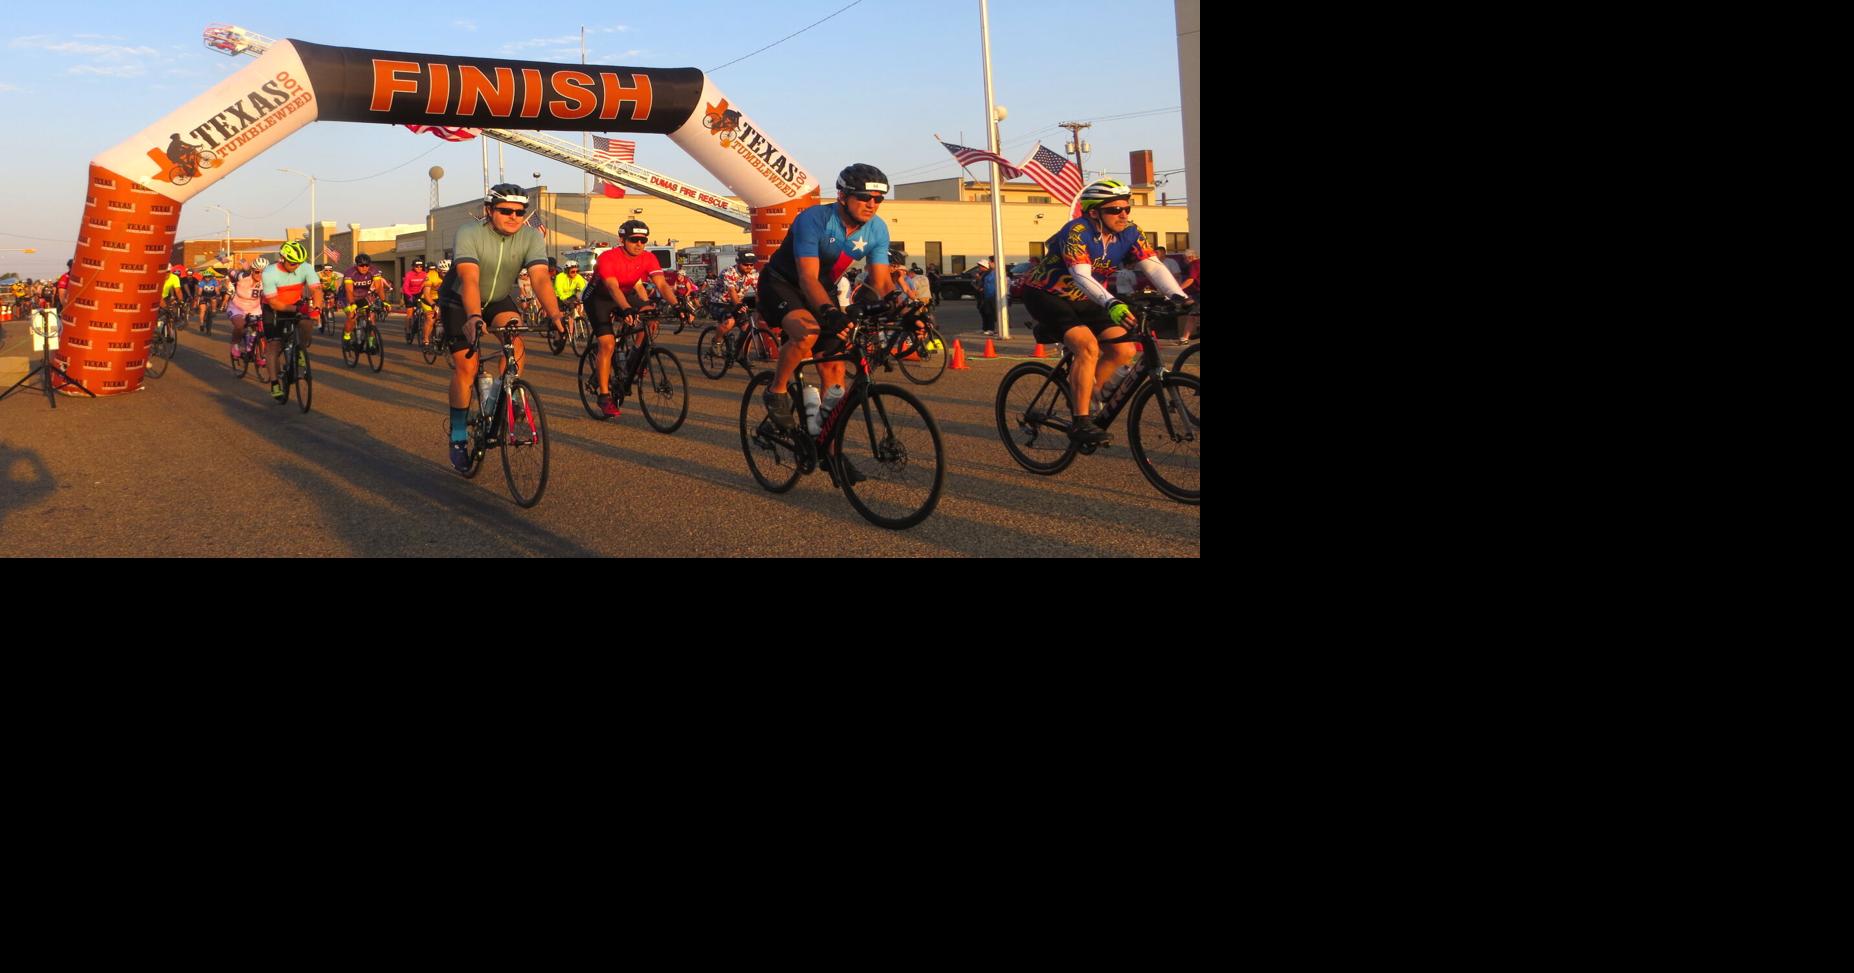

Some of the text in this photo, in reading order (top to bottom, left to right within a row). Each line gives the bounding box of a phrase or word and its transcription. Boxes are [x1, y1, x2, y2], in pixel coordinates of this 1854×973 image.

[369, 58, 653, 121] FINISH
[188, 71, 304, 150] TEXAS 100
[216, 91, 313, 158] TUMBLEWEED
[738, 121, 807, 191] TEXAS 100
[731, 140, 797, 198] TUMBLEWEED
[650, 175, 729, 210] DUMAS FIRE RESCUE
[108, 200, 132, 210] TEXAS
[127, 222, 151, 232] TEXAS
[102, 240, 126, 250] TEXAS
[82, 257, 102, 266] TEXAS
[120, 262, 144, 271] TEXAS
[95, 280, 120, 290] TEXAS
[75, 297, 95, 307] TEXAS
[114, 302, 138, 310] TEXAS
[89, 320, 114, 328] TEXAS
[107, 341, 131, 349] TEXAS
[83, 359, 108, 368] TEXAS
[102, 380, 126, 389] TEXAS
